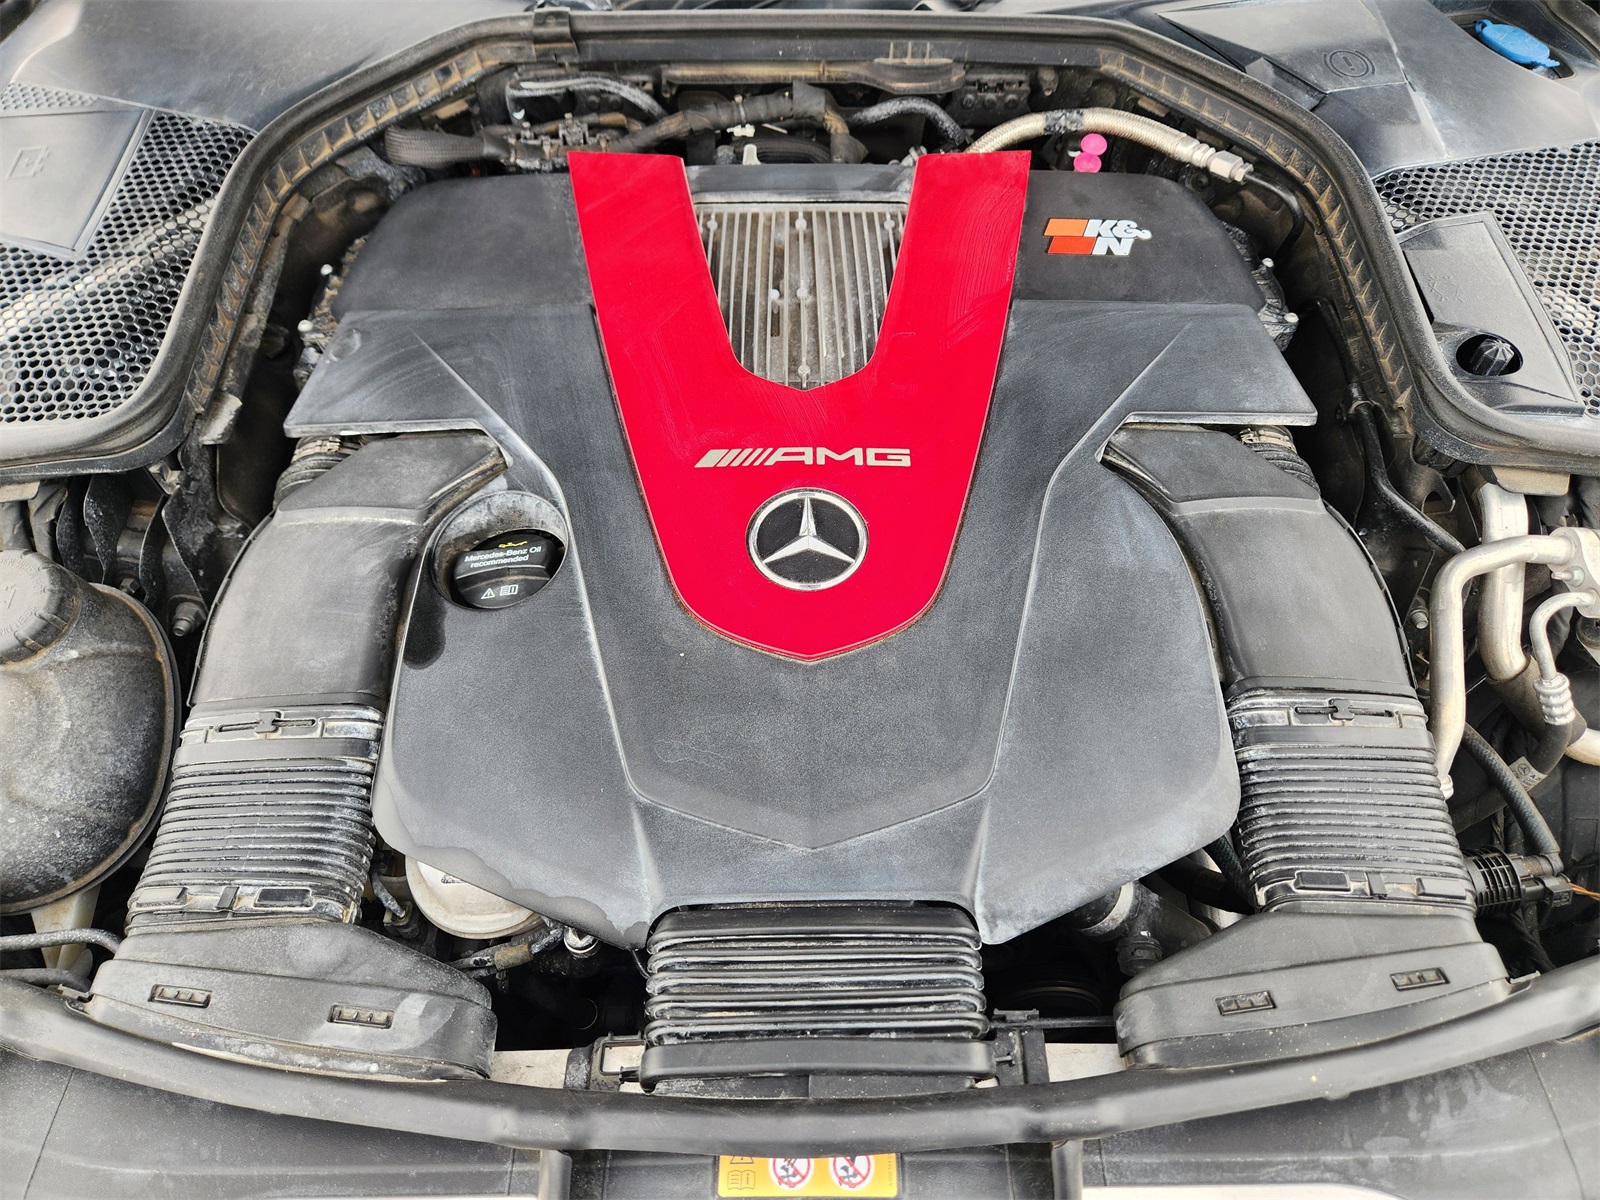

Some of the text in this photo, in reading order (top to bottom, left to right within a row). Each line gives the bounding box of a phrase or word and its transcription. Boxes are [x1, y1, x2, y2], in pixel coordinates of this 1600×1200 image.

[763, 447, 911, 467] AMG
[464, 546, 541, 562] Mercedes-Benz Oil
[470, 555, 529, 568] recommended
